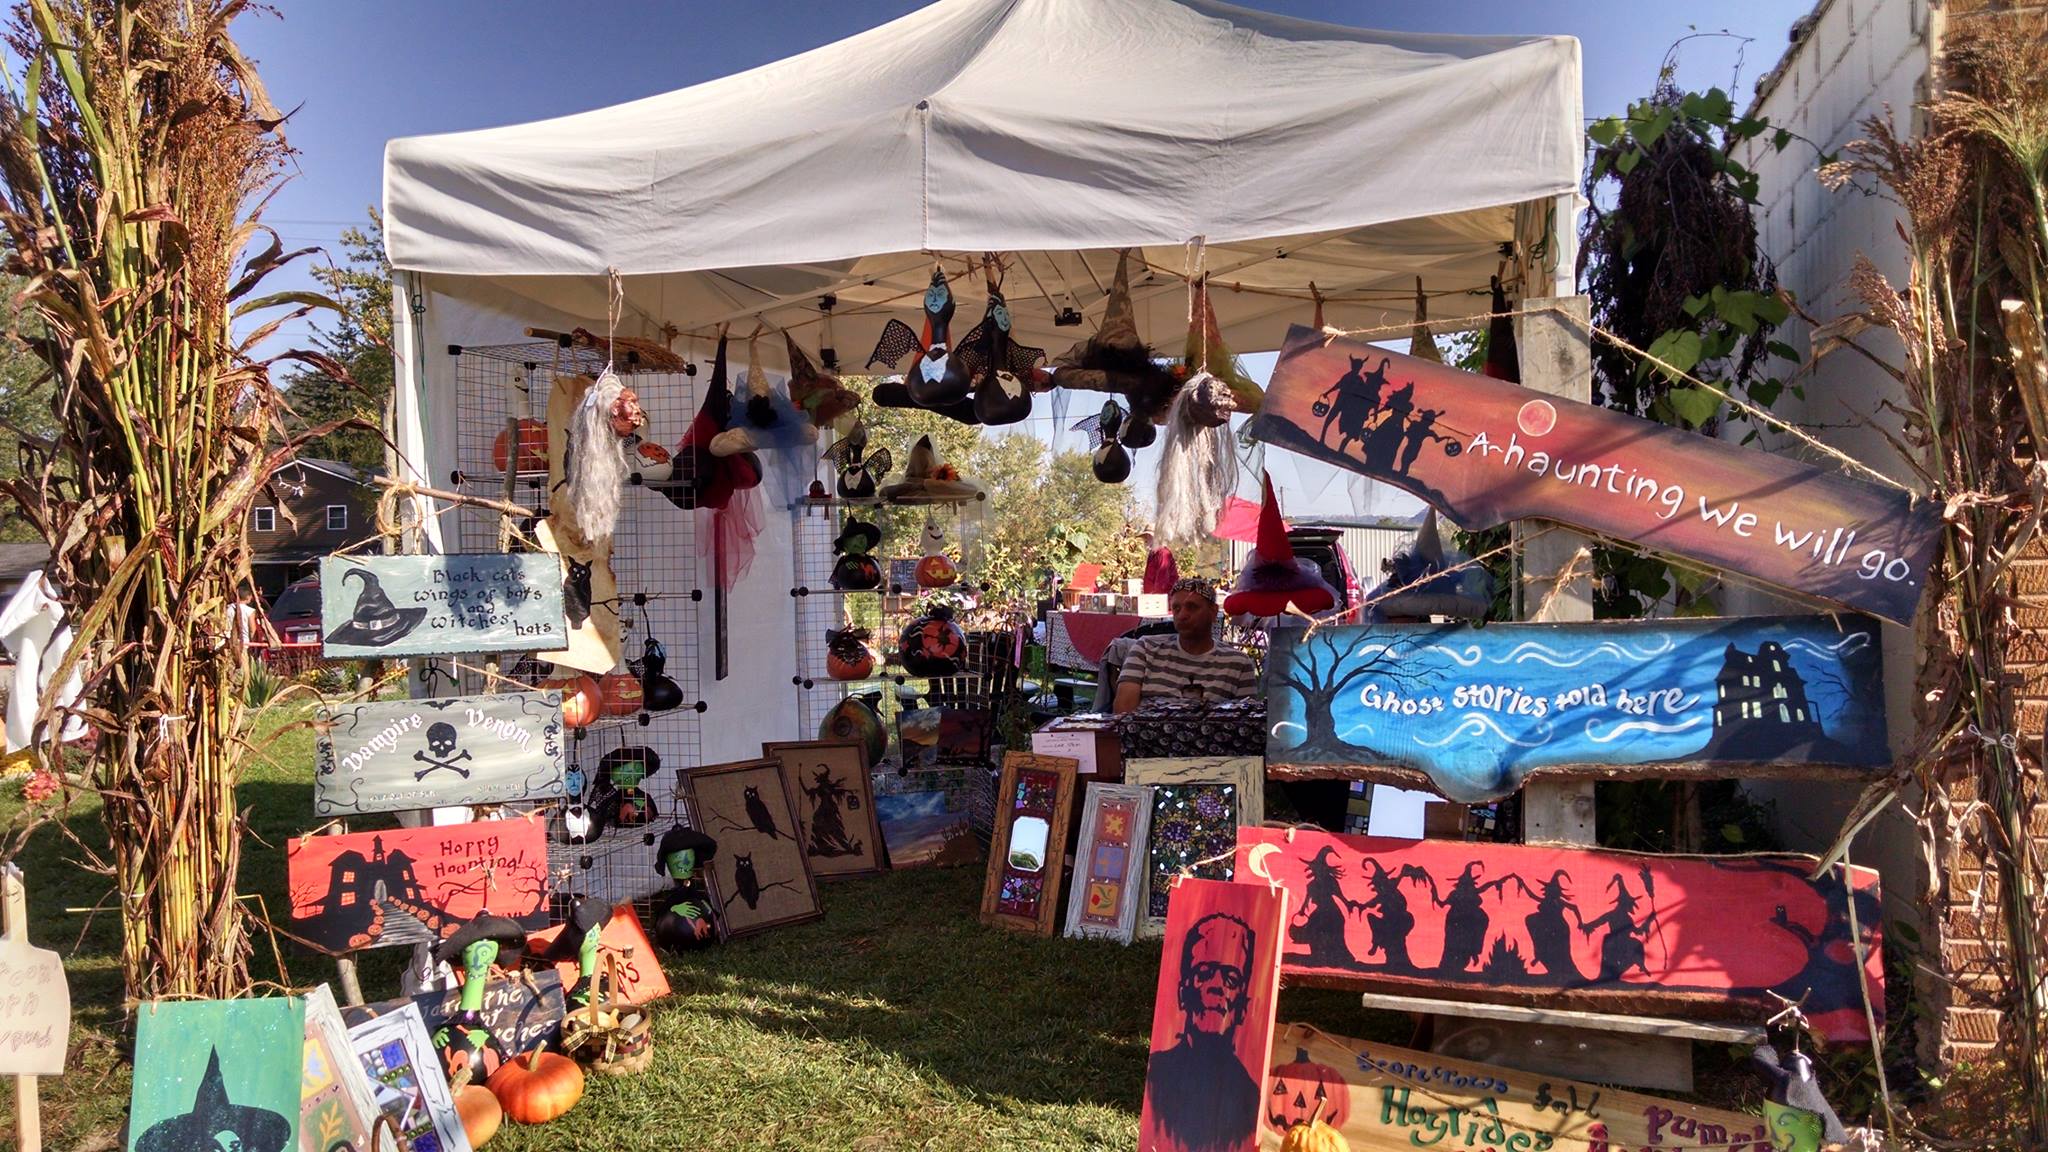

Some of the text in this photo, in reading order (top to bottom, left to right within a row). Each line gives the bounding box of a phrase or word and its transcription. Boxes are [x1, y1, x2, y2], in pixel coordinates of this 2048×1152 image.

[433, 567, 526, 583] Black cats
[1856, 549, 1916, 585] go.
[467, 602, 495, 614] and
[477, 589, 496, 604] of
[507, 586, 543, 600] bats
[514, 620, 552, 636] hats
[1360, 684, 1444, 714] Ghost
[1554, 682, 1608, 711] told
[1615, 688, 1700, 716] here
[342, 708, 531, 773] Vampire Venom
[440, 836, 498, 857] Happy
[1355, 1051, 1509, 1093] Scarecrows
[1380, 1085, 1553, 1152] Hayrides
